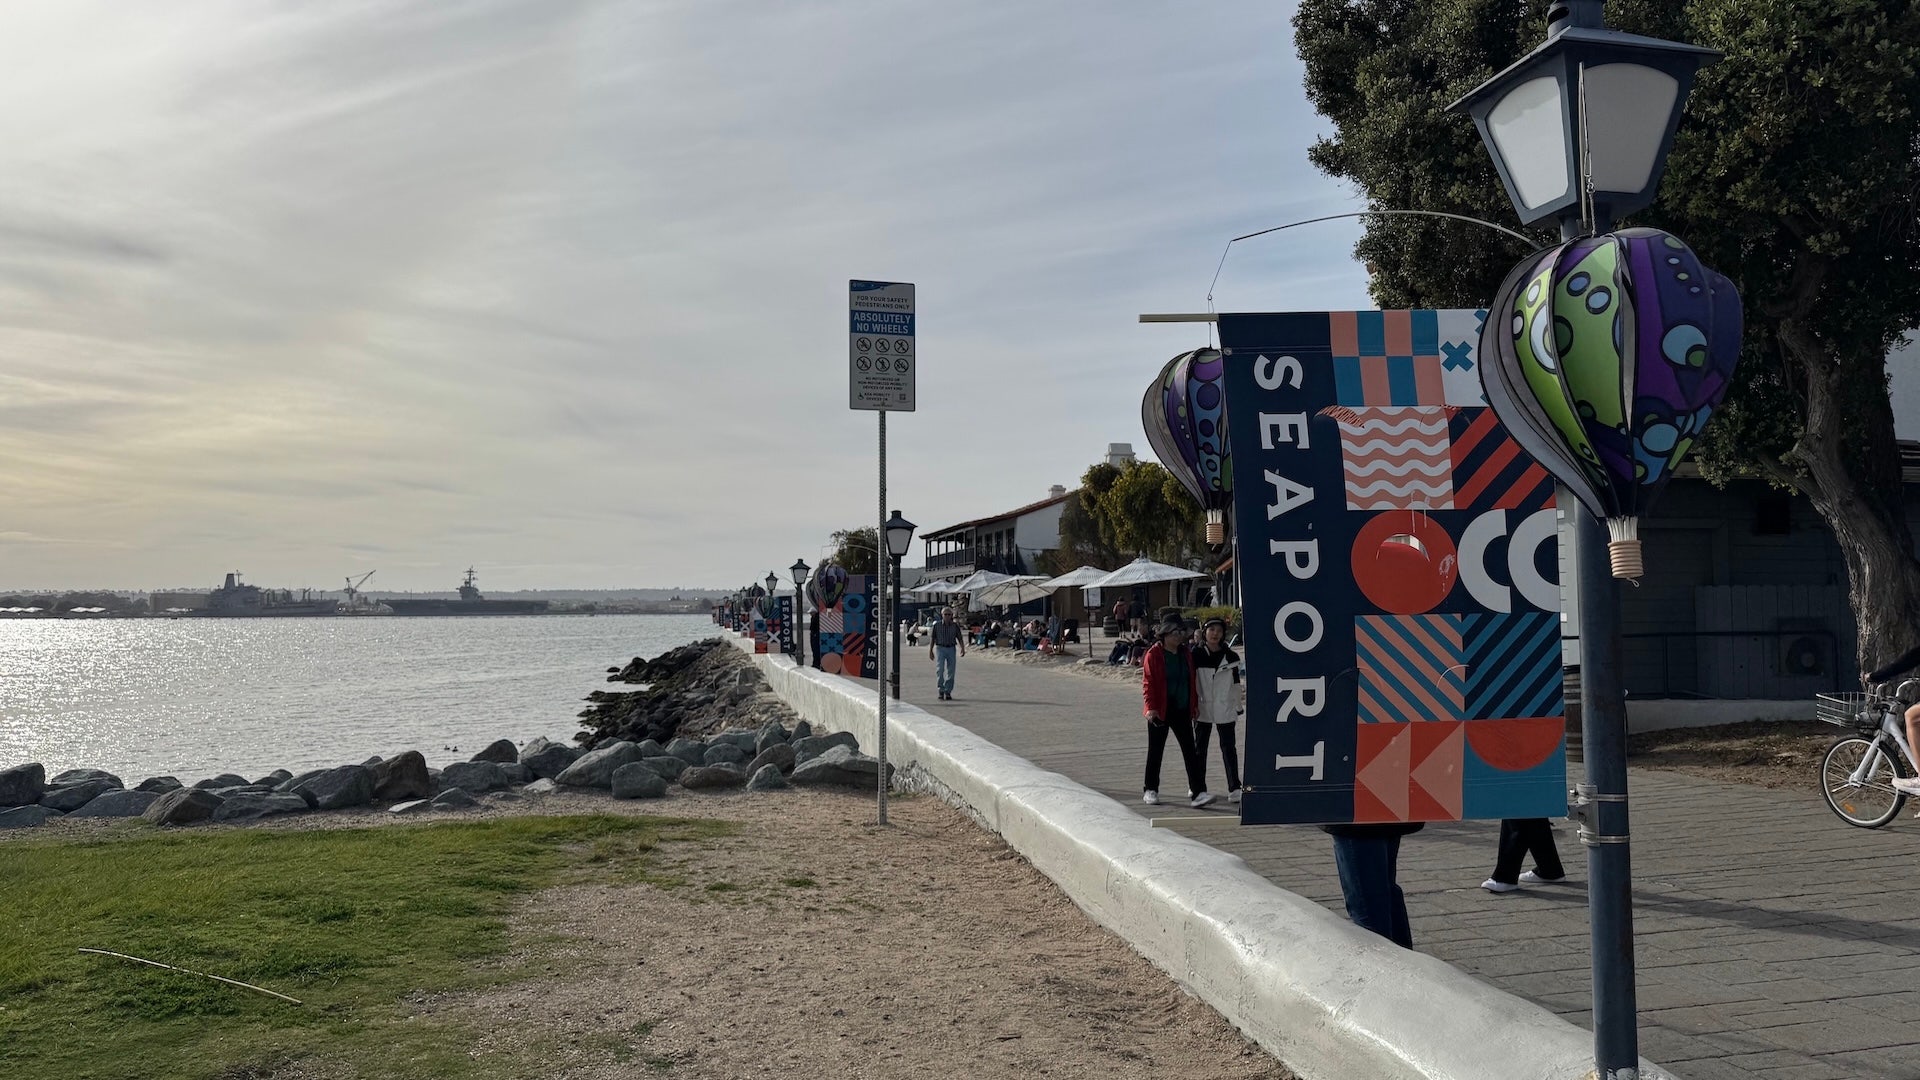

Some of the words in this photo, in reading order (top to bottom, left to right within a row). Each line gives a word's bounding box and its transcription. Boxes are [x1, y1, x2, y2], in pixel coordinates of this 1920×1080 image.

[853, 312, 911, 324] ABSOLUTELY
[856, 322, 870, 332] NO
[871, 323, 909, 334] WHEELS
[1254, 354, 1326, 781] SEAPORT
[782, 600, 790, 650] SEAPORT
[866, 583, 878, 670] SEAPORT
